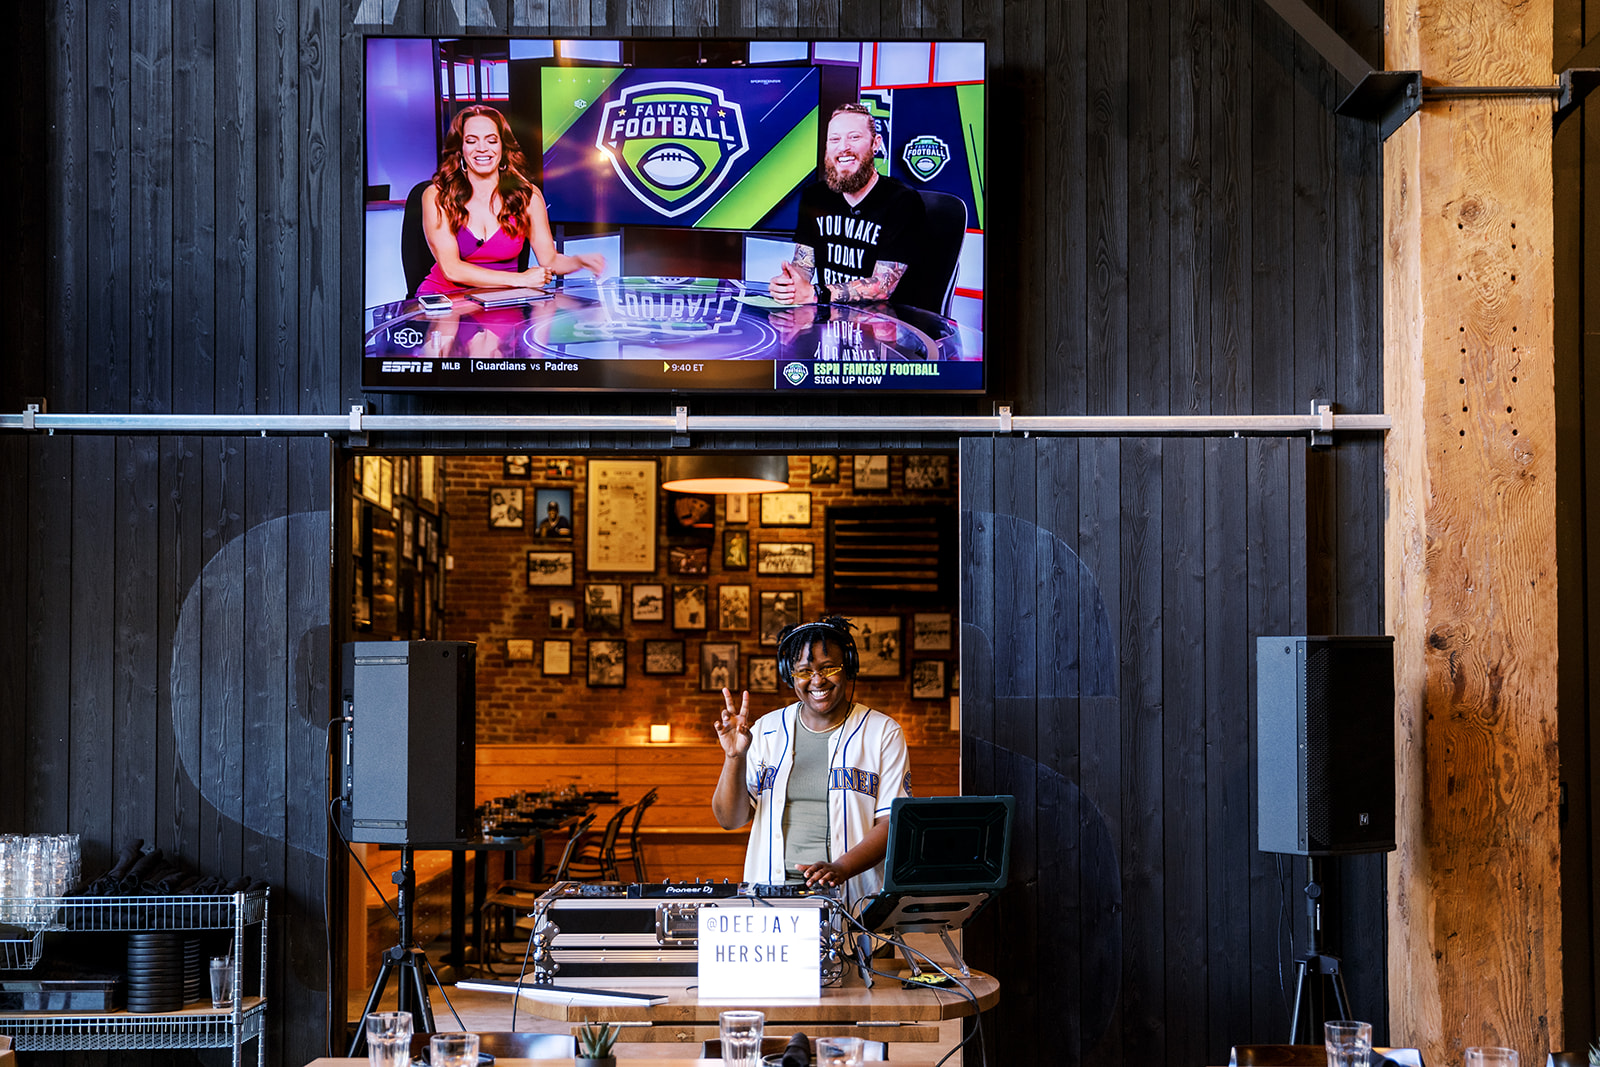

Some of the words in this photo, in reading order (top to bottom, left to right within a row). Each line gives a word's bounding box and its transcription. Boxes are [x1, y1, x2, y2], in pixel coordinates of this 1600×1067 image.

[635, 104, 709, 117] FANTASY
[610, 116, 735, 142] FOOTBALL
[907, 148, 946, 157] FOOTBALL
[816, 215, 842, 237] YOU
[844, 217, 882, 245] MAKE
[827, 242, 865, 269] TODAY
[824, 268, 865, 285] BETT
[441, 362, 461, 370] MLB
[475, 361, 527, 371] Guardians
[530, 363, 541, 371] vs
[544, 361, 579, 371] Padres
[671, 363, 692, 372] 9:40
[693, 363, 704, 372] ET
[813, 363, 841, 376] ESPN
[842, 363, 888, 376] FANTASY
[889, 363, 940, 376] FOOTBALL
[814, 376, 840, 385] SIGN
[841, 376, 856, 385] UP
[857, 376, 882, 385] NOW
[665, 886, 702, 894] Pioneer
[716, 944, 789, 963] HERSHE
